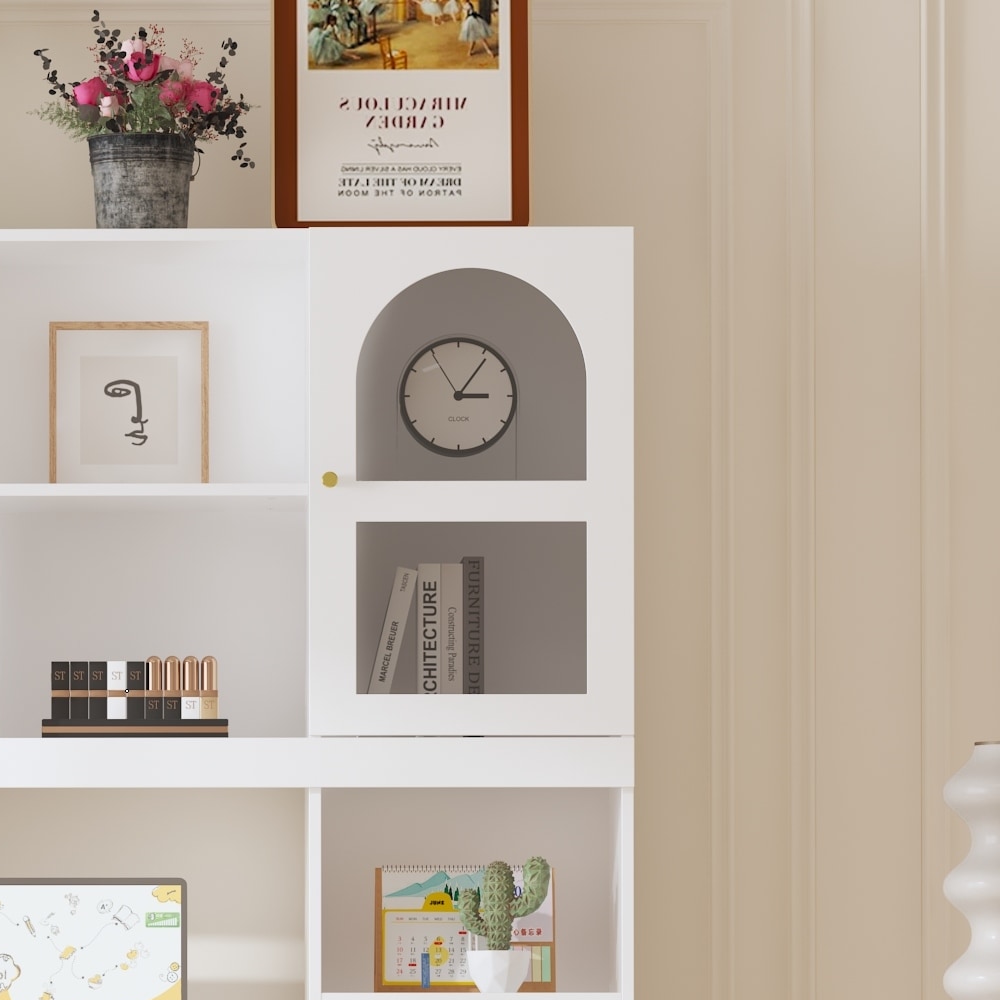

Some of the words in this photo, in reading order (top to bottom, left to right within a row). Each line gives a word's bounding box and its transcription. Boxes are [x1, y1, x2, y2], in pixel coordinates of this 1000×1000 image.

[468, 560, 480, 666] FURNITURE
[445, 607, 457, 652] Constructing
[378, 652, 393, 683] MARCEL
[386, 620, 399, 651] BREUER
[54, 671, 66, 680] ST
[73, 671, 84, 680] ST
[92, 671, 103, 680] ST
[111, 671, 123, 680] ST
[130, 671, 141, 680] ST
[148, 700, 160, 709] ST
[167, 700, 178, 709] ST
[185, 700, 197, 709] ST
[204, 700, 215, 709] ST
